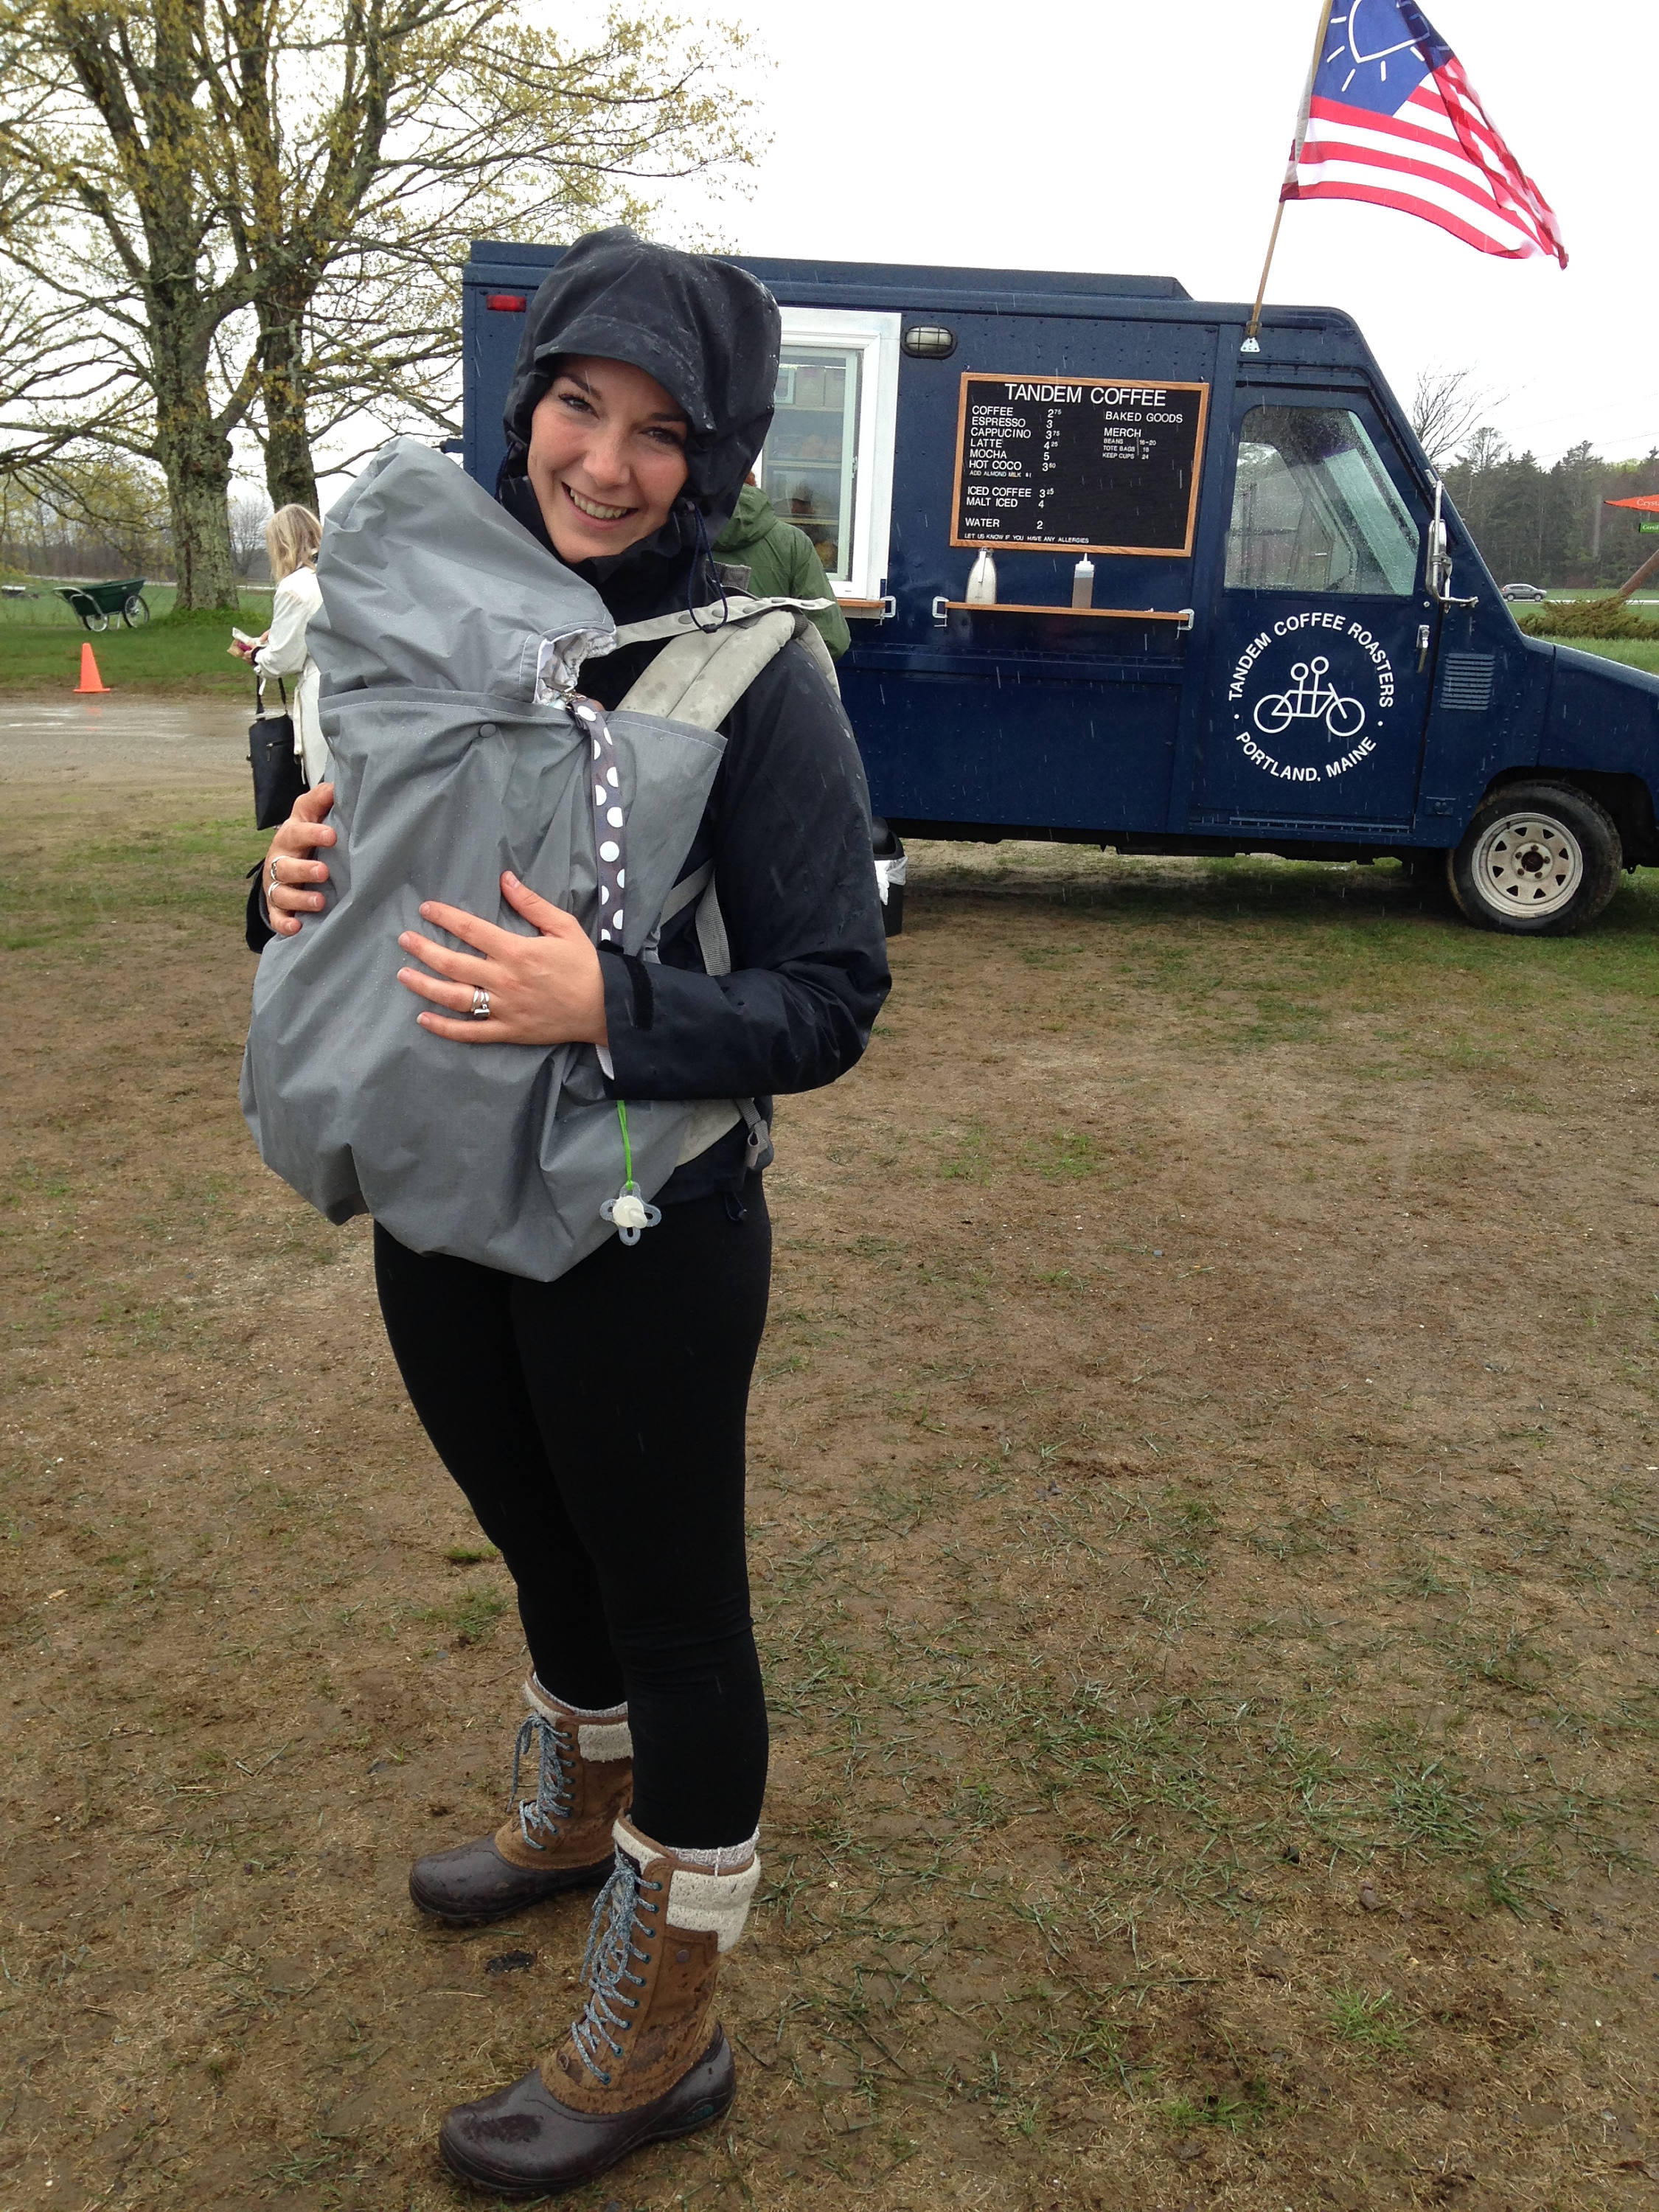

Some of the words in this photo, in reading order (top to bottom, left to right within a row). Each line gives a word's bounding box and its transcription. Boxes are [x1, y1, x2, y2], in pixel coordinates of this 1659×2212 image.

[1004, 383, 1082, 403] TANDEM
[1091, 387, 1167, 406] COFFEE
[972, 406, 1014, 416] COFFEE
[1105, 411, 1142, 422] BAKED
[1146, 413, 1183, 423] GOODS
[972, 417, 1026, 428] ESPRESSO
[1046, 420, 1053, 428] 3
[970, 427, 1032, 439] CAPPUCINO
[1104, 428, 1142, 437] MERCH
[970, 438, 1003, 448] LATTE
[970, 449, 1007, 459] MOCHA
[1043, 451, 1050, 461] 5
[969, 459, 989, 469] HOT
[992, 460, 1022, 470] COCO
[967, 486, 990, 495] ICED
[992, 487, 1032, 498] COFFEE
[967, 497, 991, 507] MALT
[996, 498, 1018, 508] ICED
[1038, 500, 1045, 509] 4
[964, 518, 1000, 528] WATER
[1036, 520, 1043, 529] 2
[1228, 632, 1272, 701] TANDEM
[1273, 612, 1346, 636] COFFEE
[1347, 622, 1394, 708] ROASTERS
[1236, 731, 1321, 782] PORTLAND,
[1325, 736, 1377, 778] MAINE
